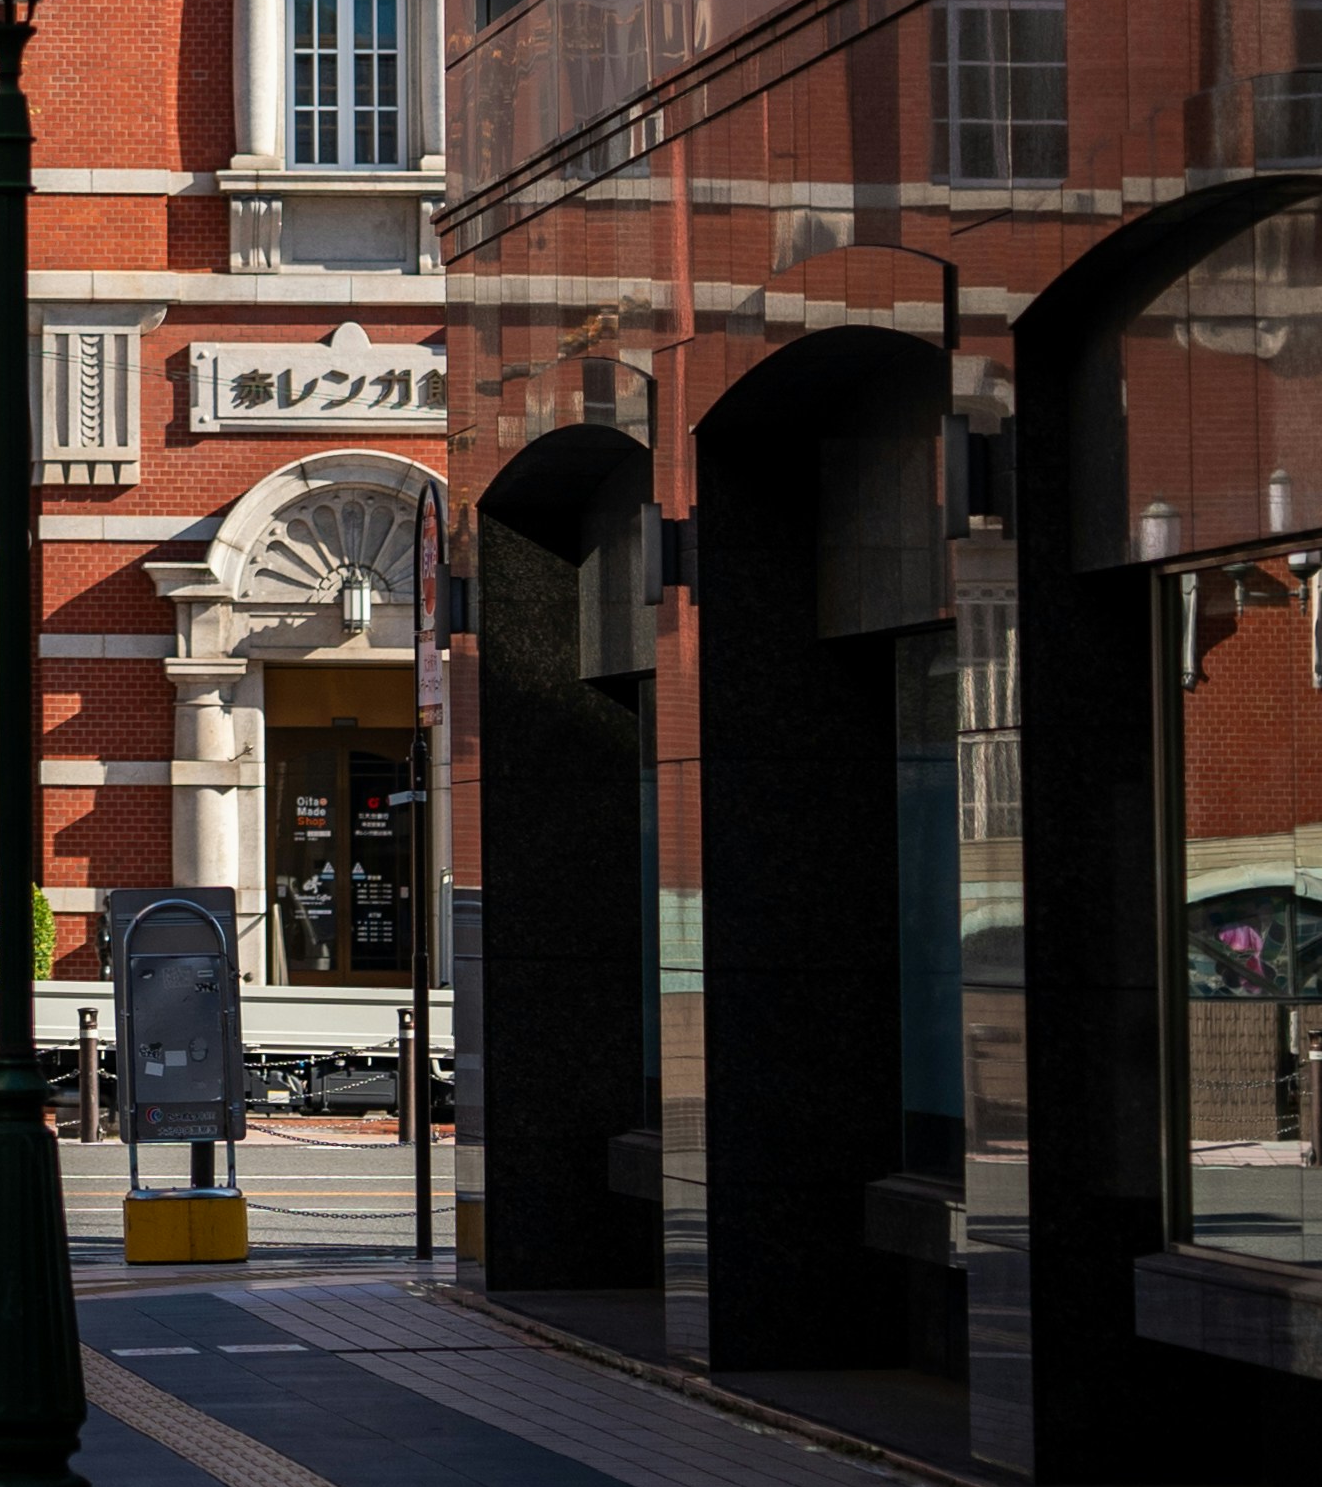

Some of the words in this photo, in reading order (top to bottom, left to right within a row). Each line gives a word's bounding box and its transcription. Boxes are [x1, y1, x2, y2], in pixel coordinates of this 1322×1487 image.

[296, 796, 319, 807] Oita
[296, 807, 327, 816] Made
[297, 817, 326, 827] Shop
